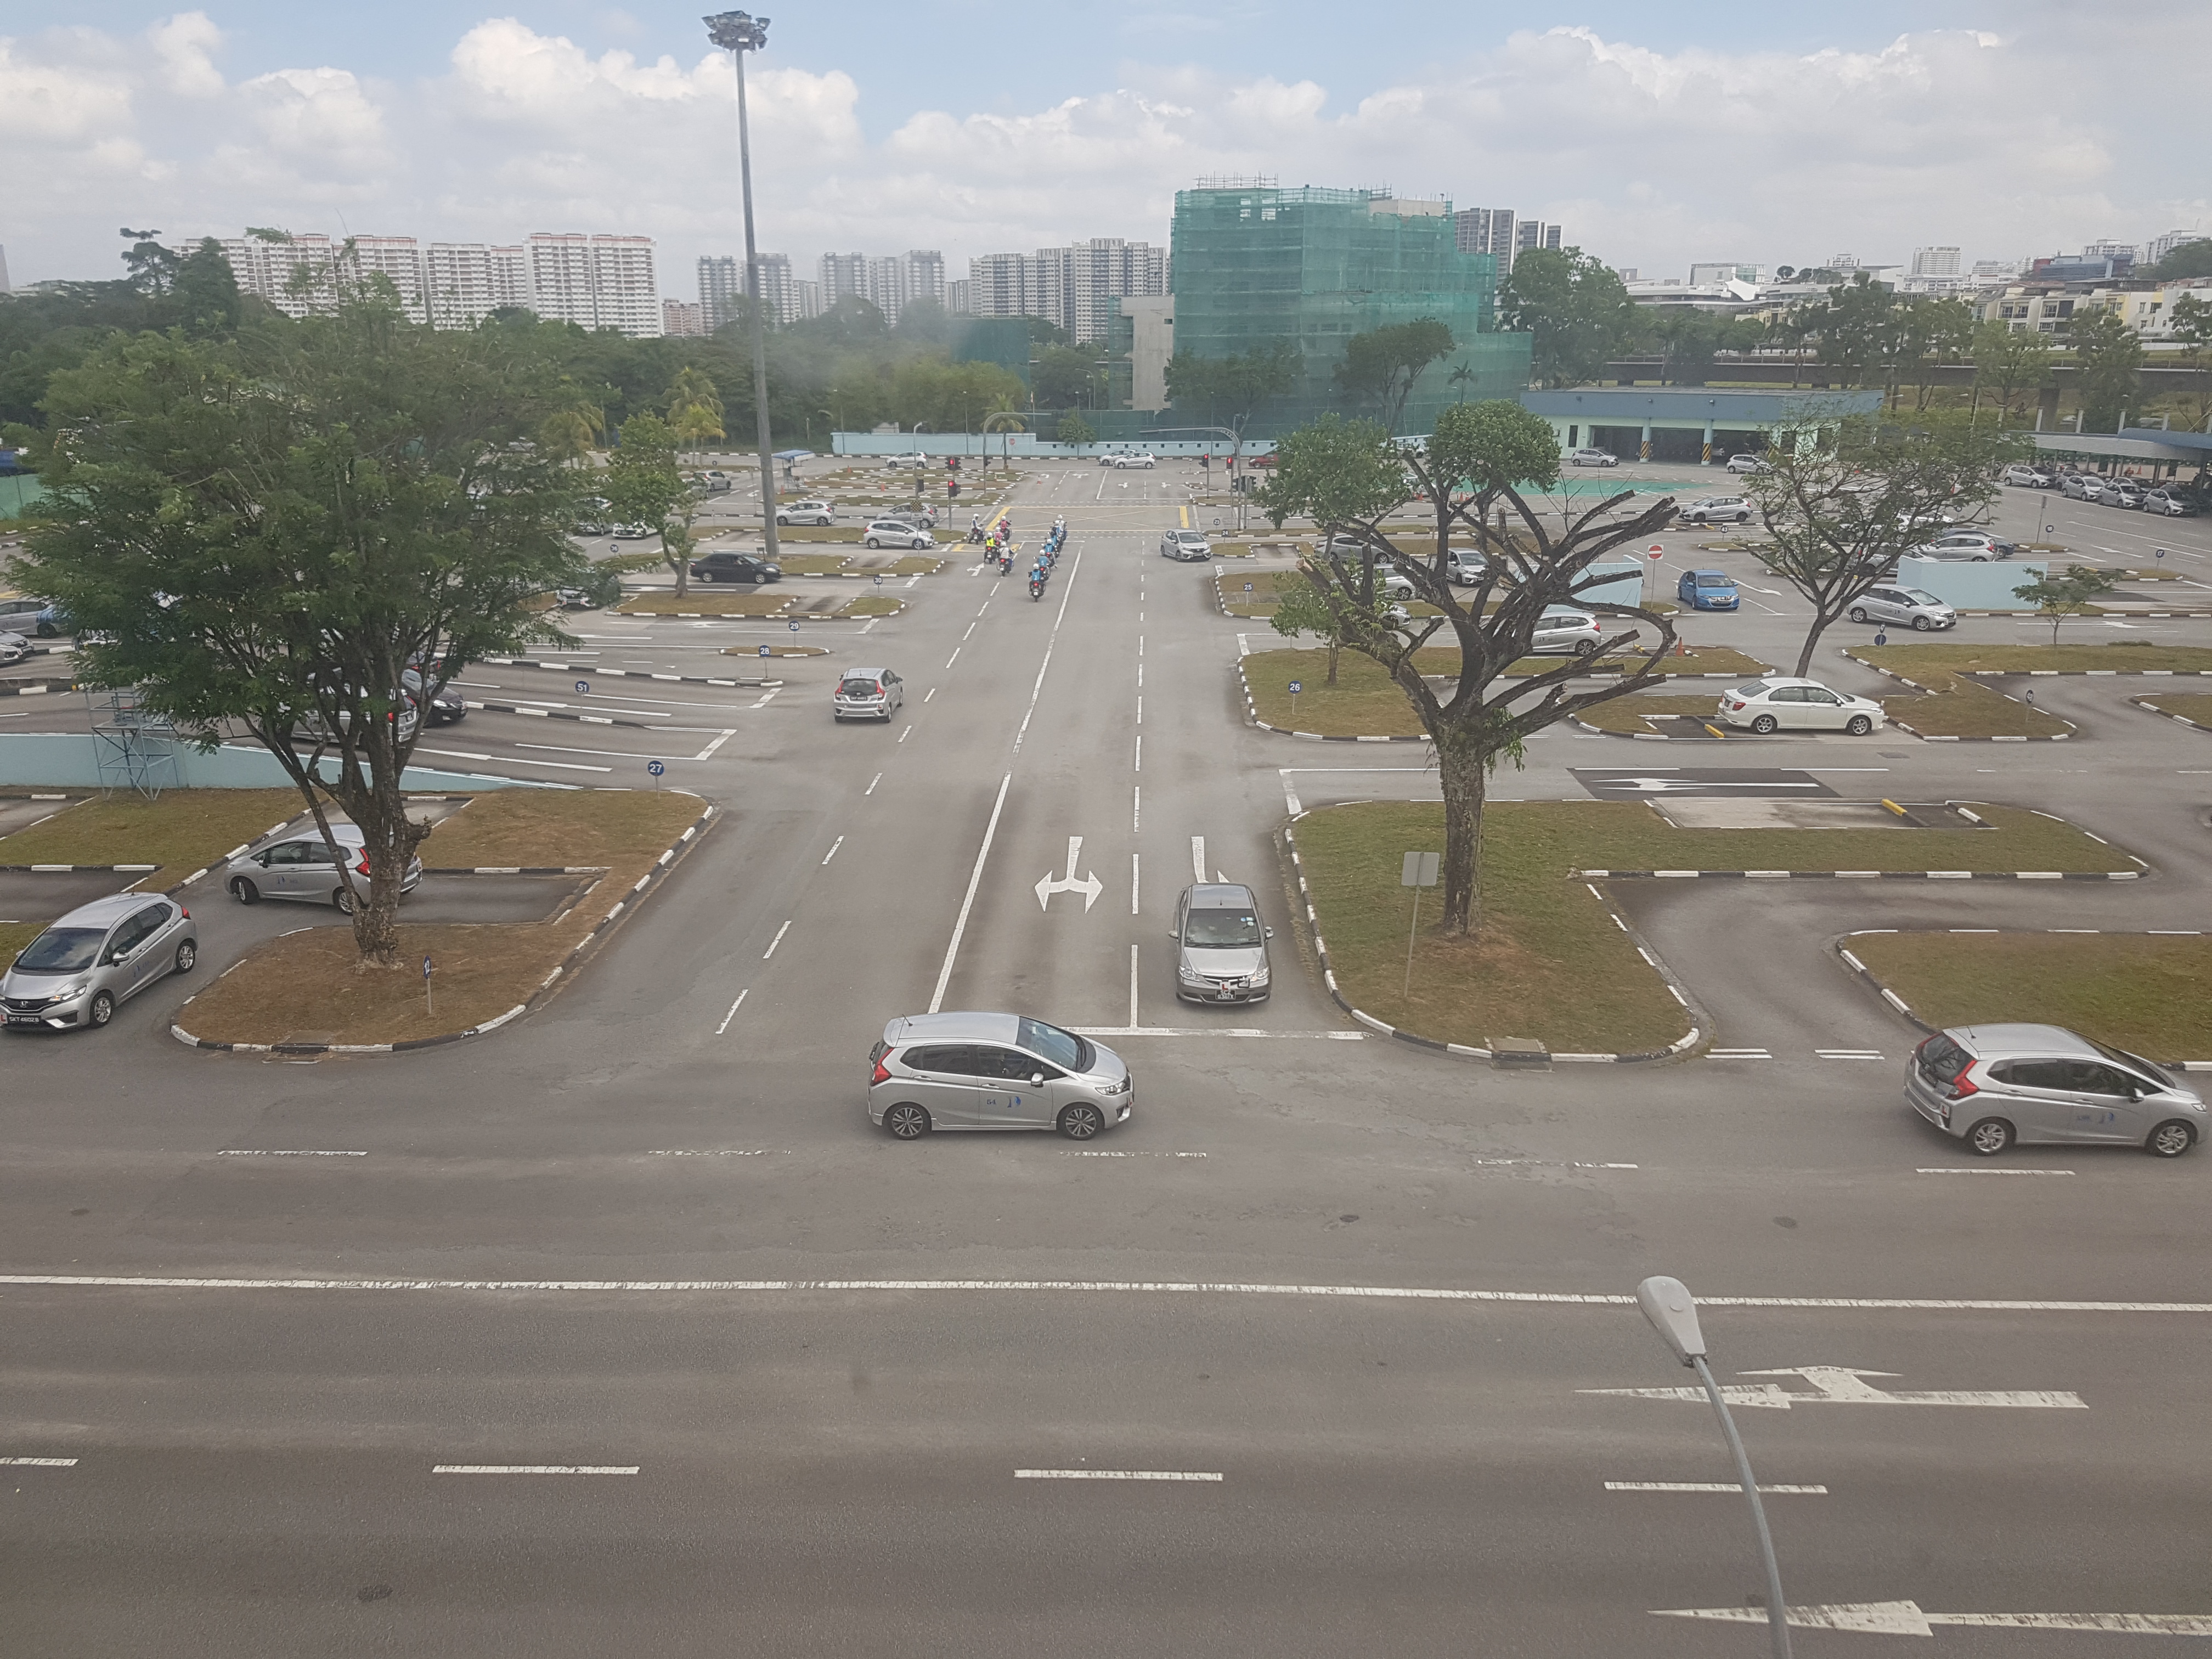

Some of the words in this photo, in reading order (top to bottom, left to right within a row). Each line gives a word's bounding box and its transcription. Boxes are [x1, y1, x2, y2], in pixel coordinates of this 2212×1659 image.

[577, 684, 588, 692] 51
[1289, 683, 1300, 691] 26
[649, 764, 662, 773] 27
[424, 960, 430, 975] 12
